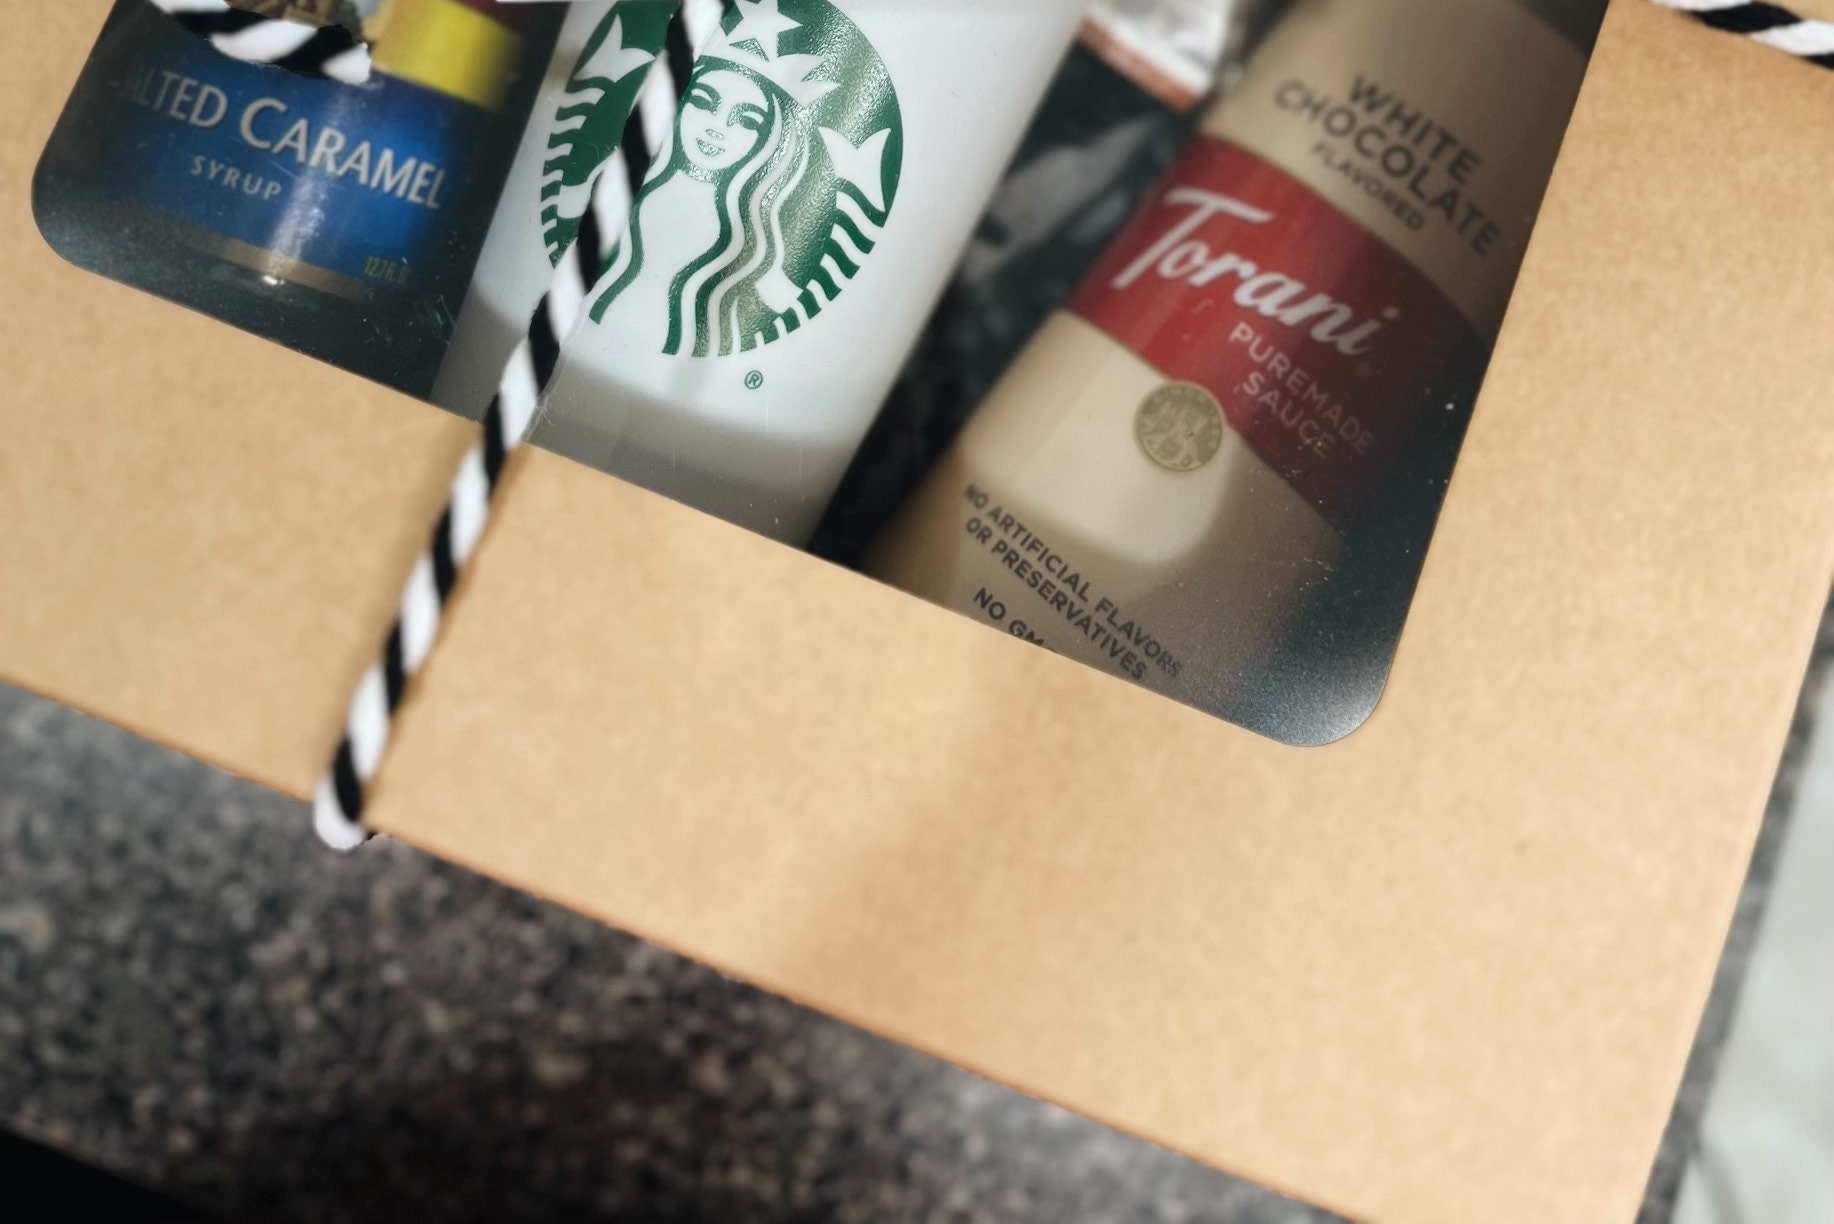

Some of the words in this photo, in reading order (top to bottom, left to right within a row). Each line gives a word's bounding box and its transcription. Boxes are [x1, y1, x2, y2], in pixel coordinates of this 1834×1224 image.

[190, 154, 282, 202] SYRUP
[239, 97, 446, 210] CARAMEL
[1275, 80, 1501, 257] CHOCOLATE
[1311, 141, 1427, 232] FLAVORED
[1349, 75, 1483, 187] WHITE
[1111, 186, 1399, 356] Torani
[1230, 322, 1376, 456] PUREMADE
[1242, 371, 1337, 460] SAUCE
[965, 484, 989, 509] NO
[988, 506, 1091, 603] ARTIFICIAL
[1095, 596, 1182, 678] FLAVORS
[966, 517, 993, 545] OR
[991, 539, 1150, 680] PRESERVATIVES
[973, 587, 1007, 621] NO
